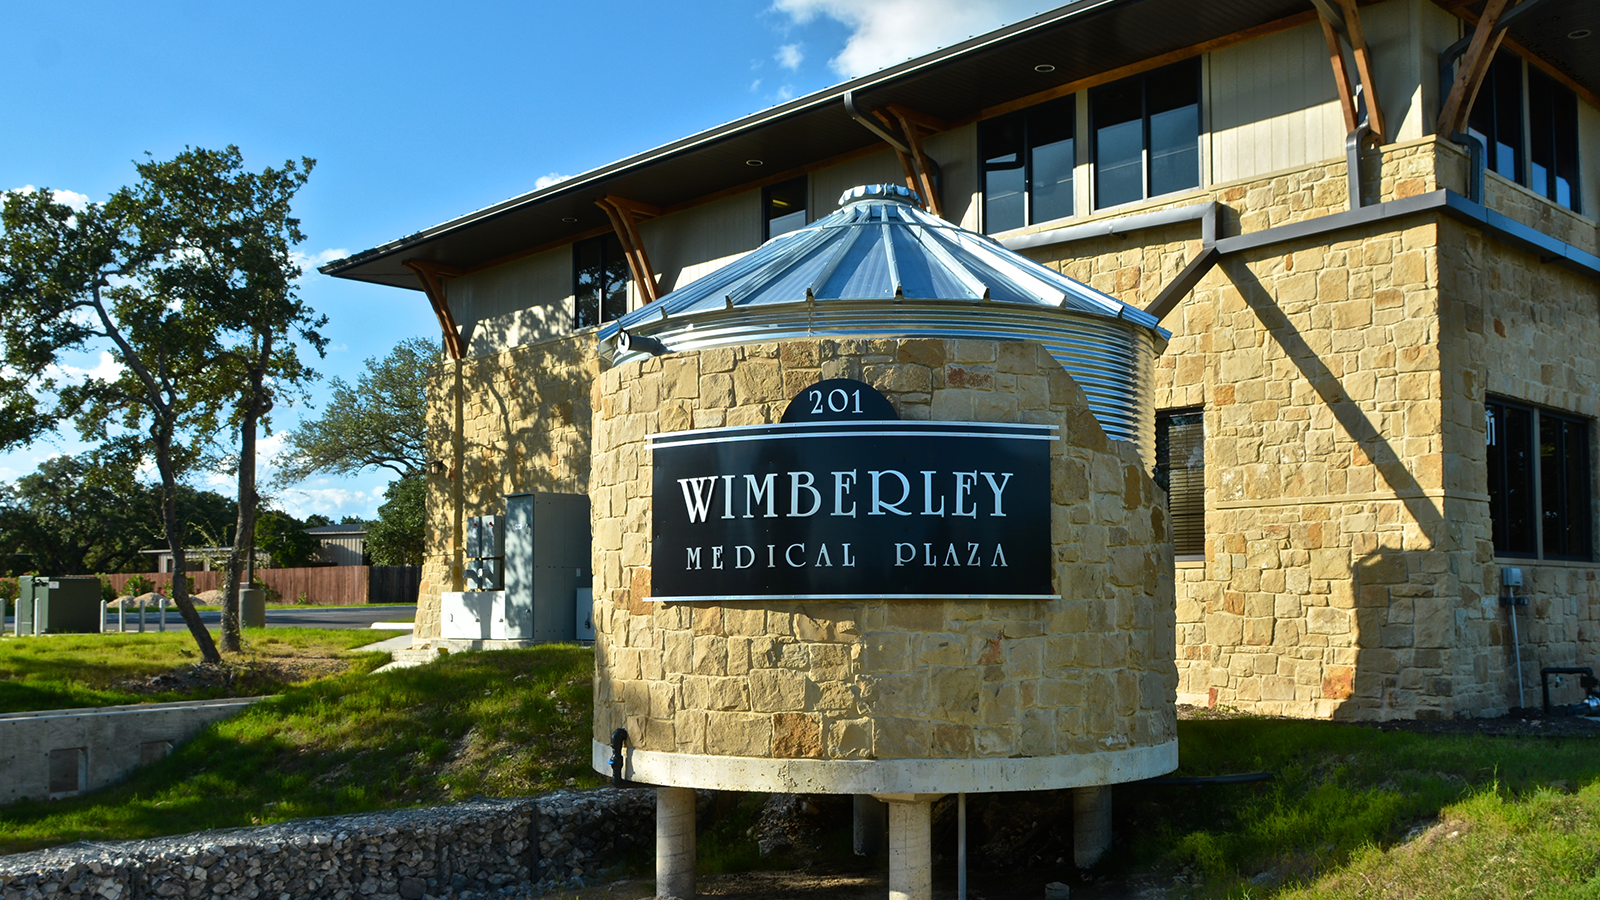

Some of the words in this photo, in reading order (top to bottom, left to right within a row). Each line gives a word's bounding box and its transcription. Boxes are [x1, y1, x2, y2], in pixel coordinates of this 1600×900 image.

[809, 389, 864, 414] 201
[677, 469, 1013, 524] WIMBERLEY
[686, 542, 855, 571] MEDICAL
[894, 541, 1008, 567] PLAZA
